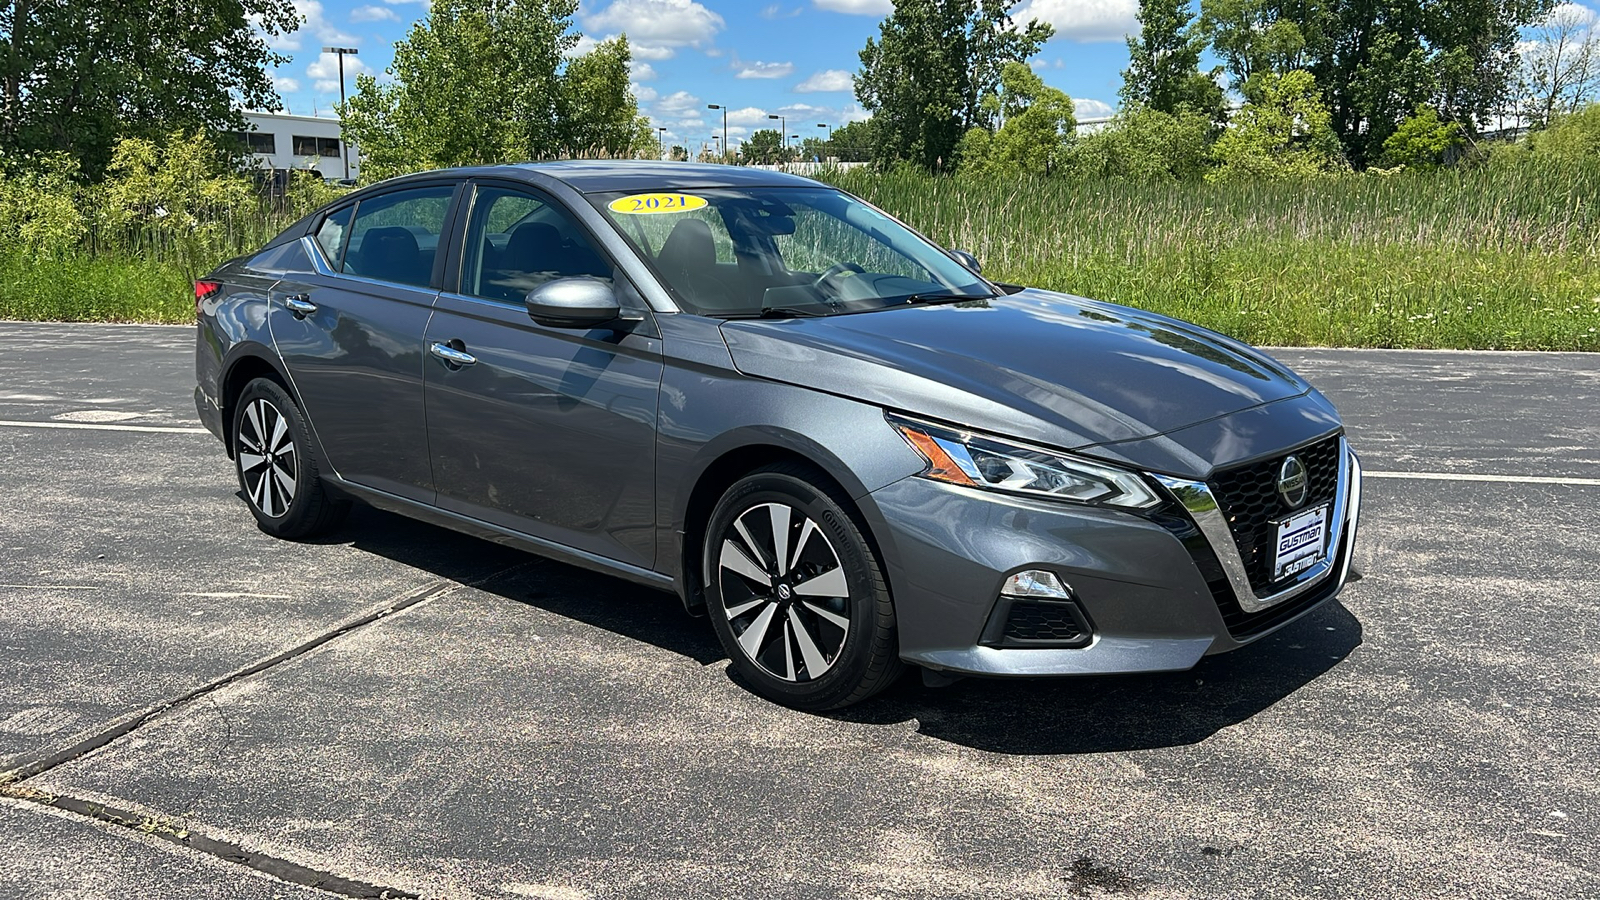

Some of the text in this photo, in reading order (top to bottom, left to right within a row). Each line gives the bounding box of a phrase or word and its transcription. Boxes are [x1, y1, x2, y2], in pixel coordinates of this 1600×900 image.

[629, 196, 686, 212] 2021
[1284, 475, 1306, 489] NISSAN
[822, 509, 865, 574] Continenal
